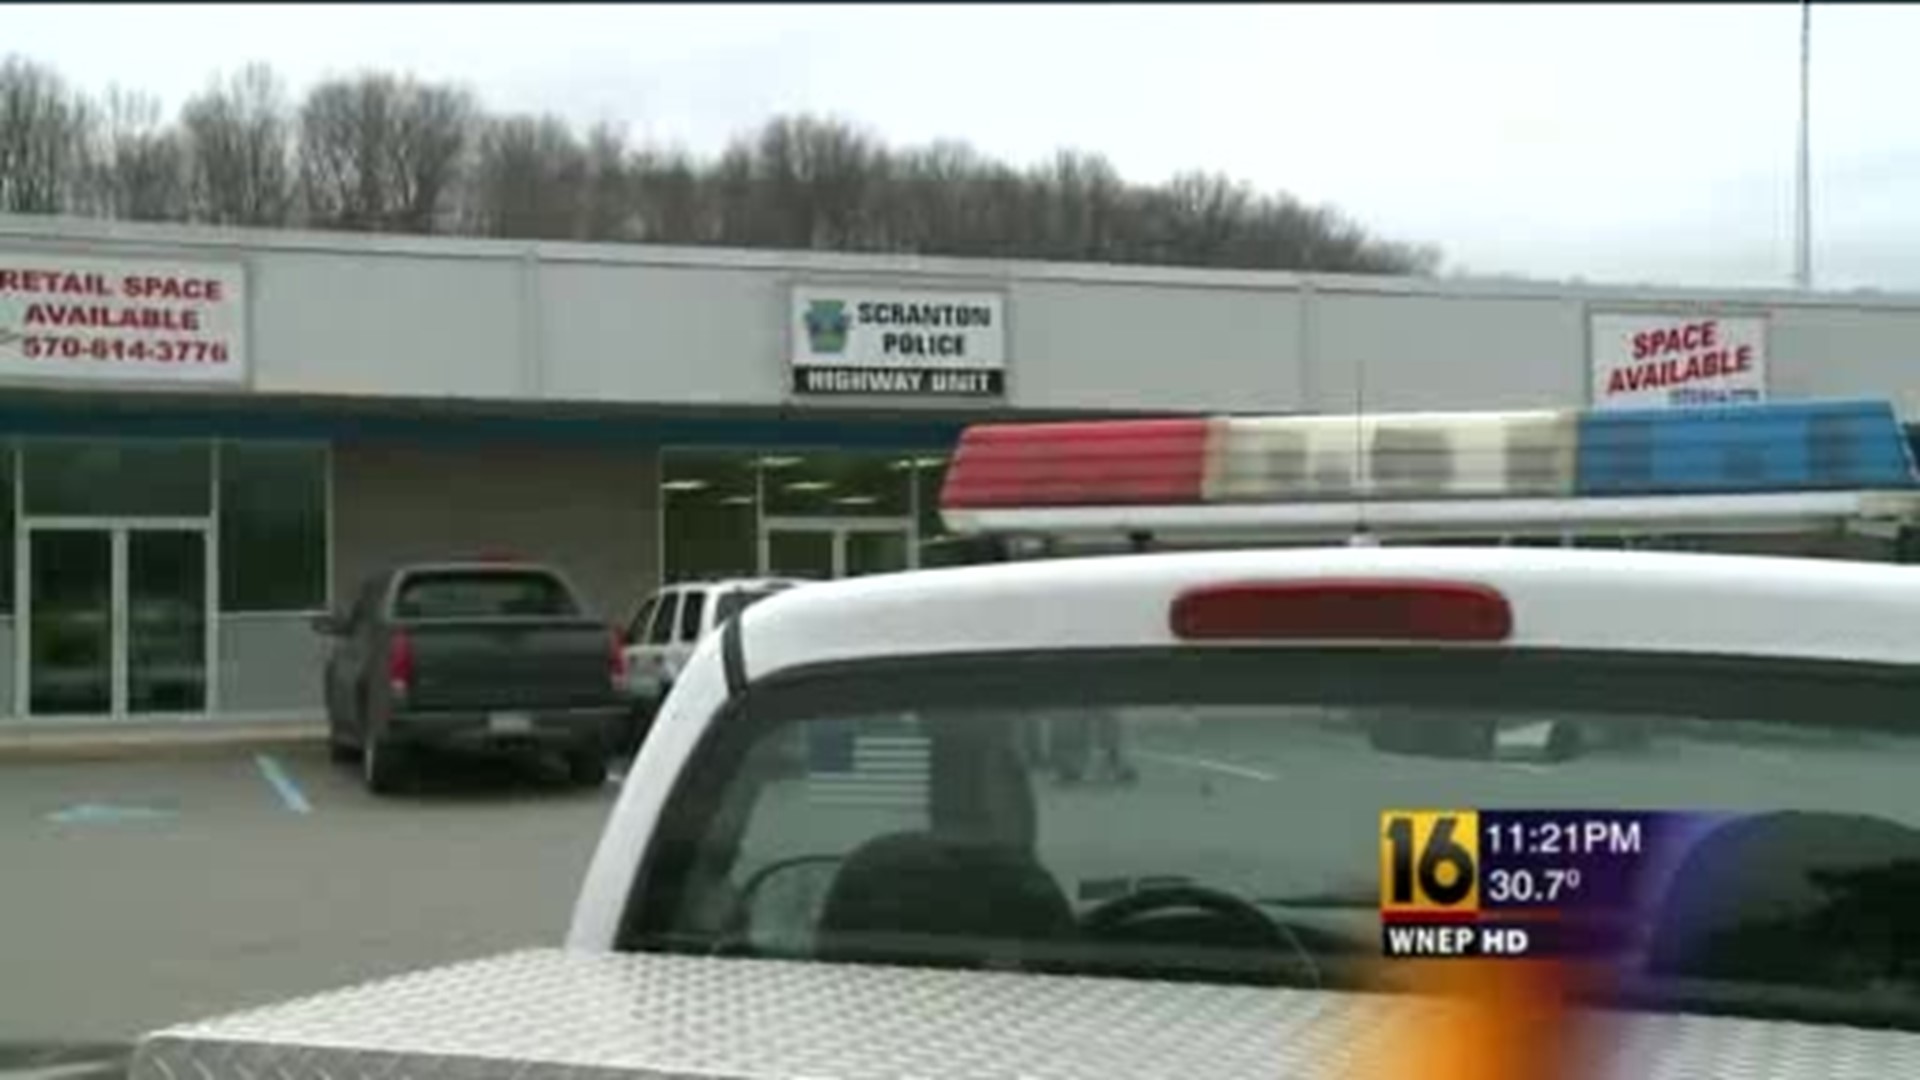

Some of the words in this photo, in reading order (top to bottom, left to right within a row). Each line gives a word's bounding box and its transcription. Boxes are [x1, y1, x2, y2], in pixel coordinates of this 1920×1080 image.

[0, 269, 113, 296] RETAIL
[122, 277, 223, 300] SPACE
[24, 303, 201, 331] AVAILABLE
[857, 302, 991, 326] SCRANTON
[882, 333, 965, 355] POLICE
[1633, 321, 1717, 360] SPACE
[807, 370, 923, 391] HIGHWAY
[932, 373, 989, 391] UNIT
[1607, 345, 1752, 395] AVAILABLE
